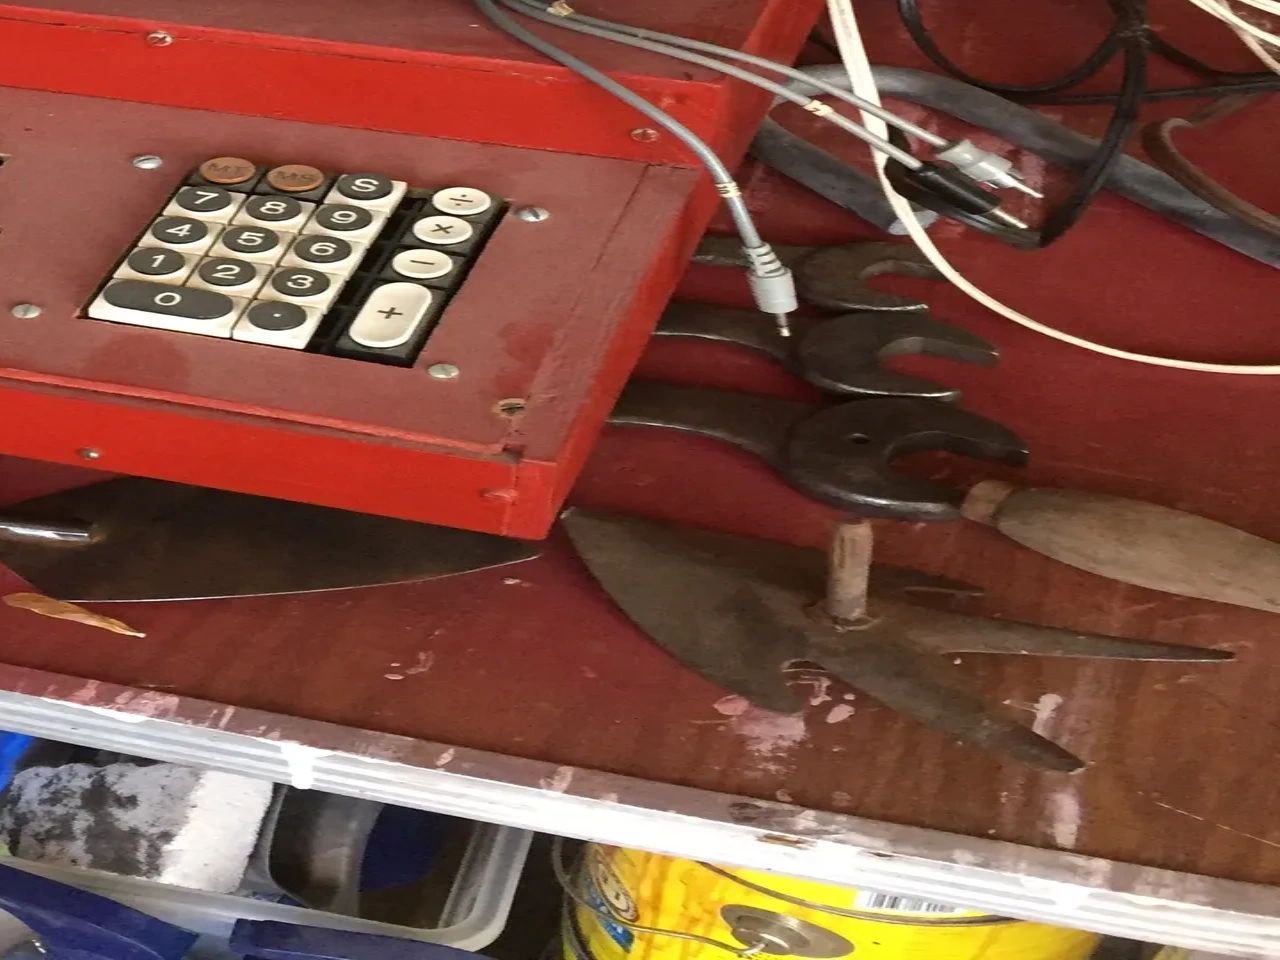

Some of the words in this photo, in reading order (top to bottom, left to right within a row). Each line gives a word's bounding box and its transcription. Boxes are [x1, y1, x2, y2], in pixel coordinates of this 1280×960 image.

[350, 178, 380, 193] S
[193, 191, 219, 205] 7
[259, 201, 287, 215] 8
[330, 210, 358, 224] 9
[165, 223, 193, 238] 4
[236, 231, 265, 247] 5
[308, 242, 337, 256] 6
[150, 254, 165, 268] 1
[211, 264, 240, 280] 2
[286, 274, 314, 289] 3
